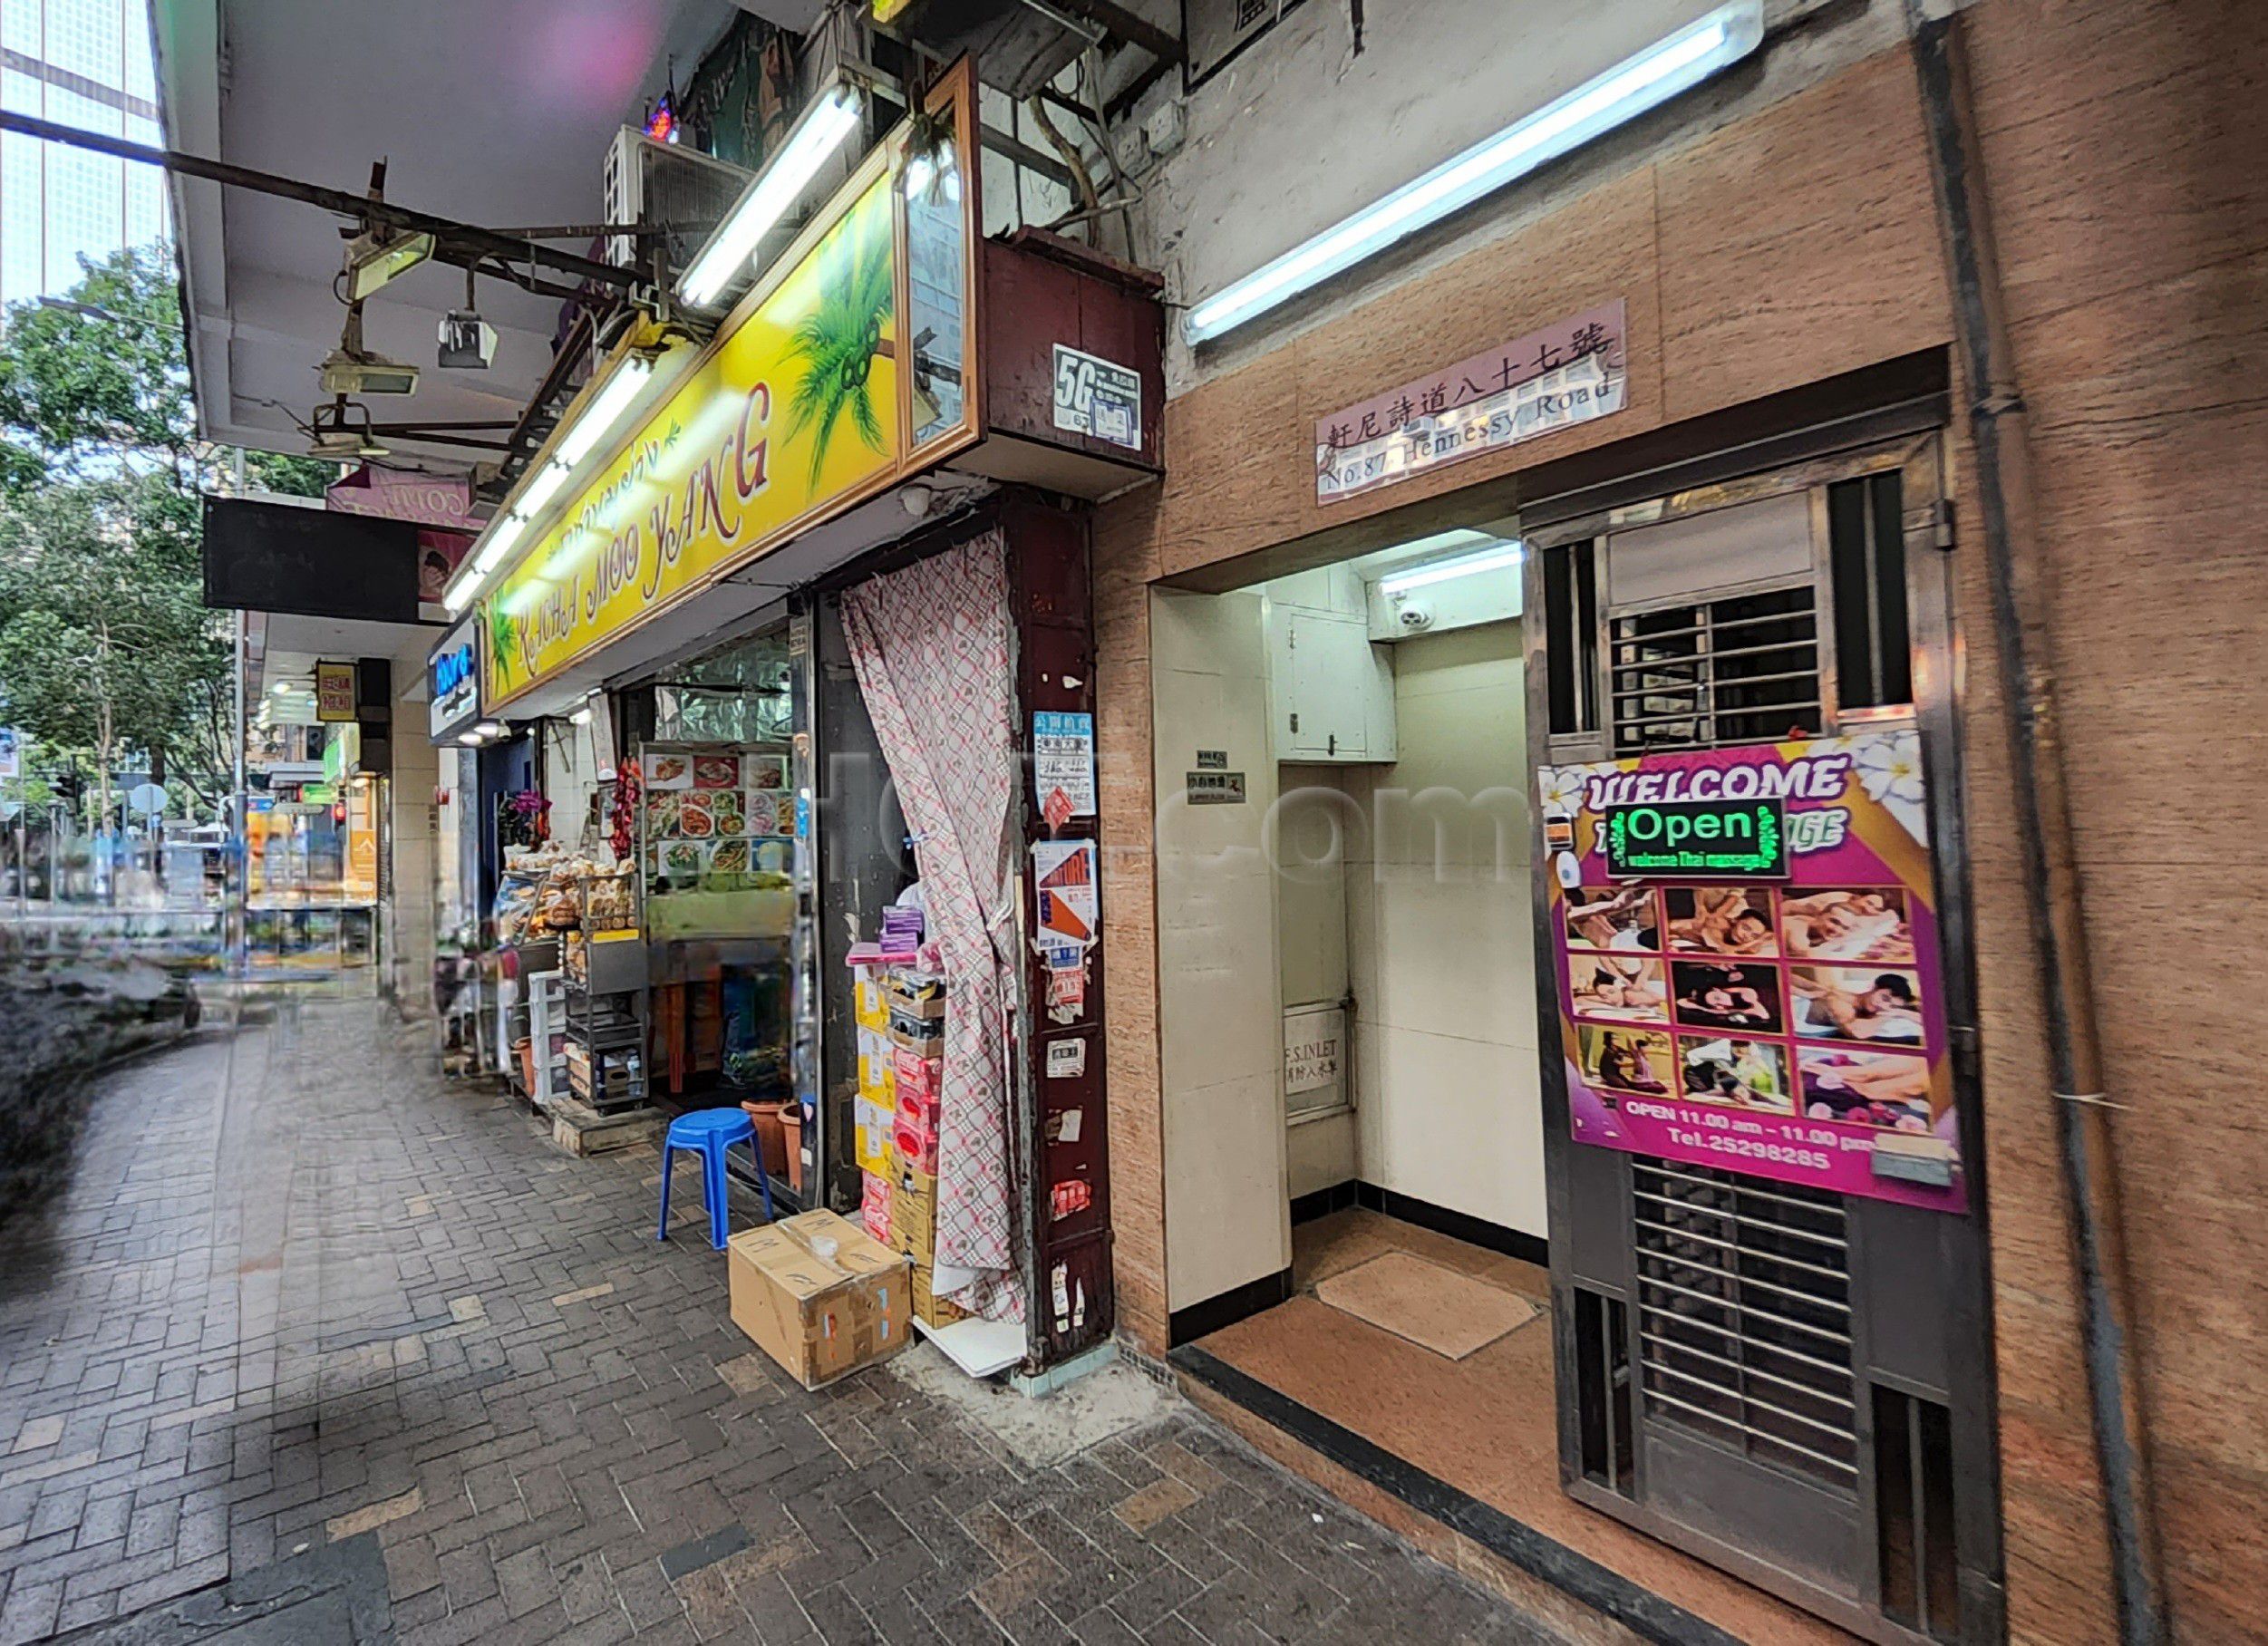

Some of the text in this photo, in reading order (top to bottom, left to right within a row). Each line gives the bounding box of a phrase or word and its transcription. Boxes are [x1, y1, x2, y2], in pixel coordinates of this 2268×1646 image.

[1055, 354, 1095, 413] 5G
[1329, 322, 1616, 447] 軒尼詩道八十七號
[1326, 372, 1610, 490] No.87 Hennessy Road
[519, 577, 580, 678] RACHA
[587, 524, 641, 620] MOO
[643, 382, 771, 601] YANG
[1589, 755, 1849, 809] WELCOME
[1627, 808, 1751, 847] Open
[1625, 1100, 1677, 1122] OPEN
[1679, 1109, 1730, 1129] 11.00
[1731, 1120, 1762, 1135] am
[1779, 1126, 1837, 1147] 11.00
